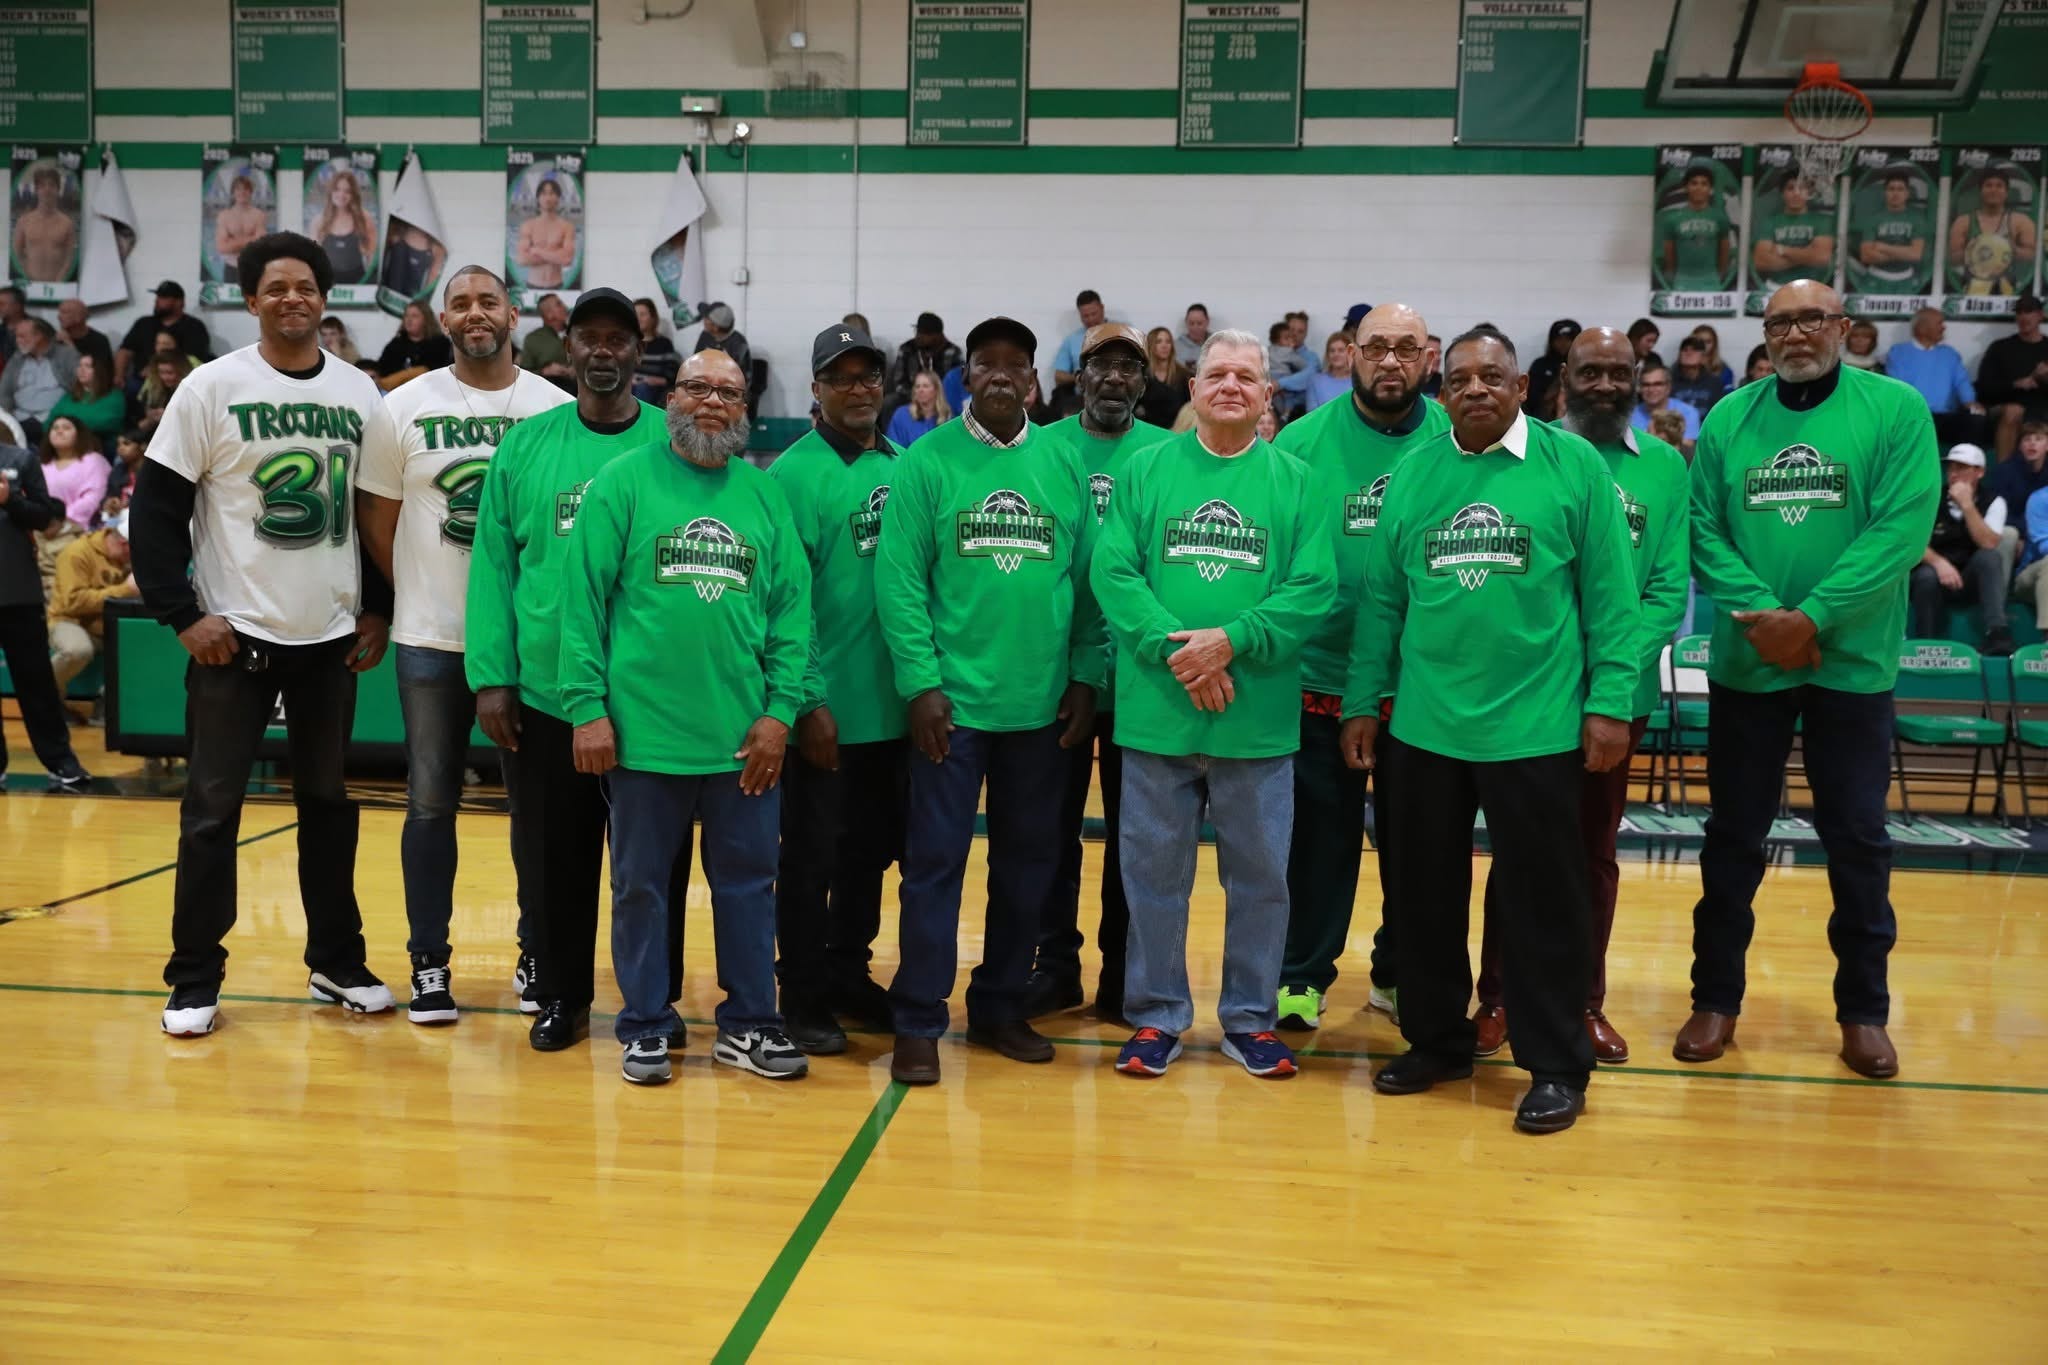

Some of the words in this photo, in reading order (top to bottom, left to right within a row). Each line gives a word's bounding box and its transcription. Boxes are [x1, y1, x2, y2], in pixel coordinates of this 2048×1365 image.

[501, 8, 577, 18] BASKETBALL
[918, 7, 960, 16] WOMEN'S
[963, 7, 1021, 16] BASKETBALL
[1207, 6, 1280, 17] WRESTLING
[1482, 3, 1567, 13] VOLLEYBALL
[1674, 295, 1706, 309] Cyrus
[839, 332, 854, 342] R
[228, 402, 364, 445] TROJANS
[414, 415, 525, 450] TROJ
[1757, 469, 1787, 478] 1975
[1794, 466, 1834, 477] STATE
[1748, 474, 1844, 494] CHAMPIONS
[251, 446, 352, 549] 31
[1357, 496, 1383, 506] 1975
[970, 513, 997, 523] 1975
[1005, 515, 1044, 526] STATE
[960, 522, 1052, 543] CHAMPIONS
[1178, 520, 1207, 533] 1975
[1215, 524, 1256, 537] STATE
[1437, 530, 1466, 541] 1975
[1473, 527, 1517, 538] STATE
[669, 538, 699, 550] 1975
[707, 543, 747, 557] STATE
[1167, 529, 1264, 555] CHAMPIONS
[1428, 537, 1527, 559] CHAMPIONS
[659, 547, 754, 576] CHAMPIONS
[1917, 647, 1950, 656] WEST
